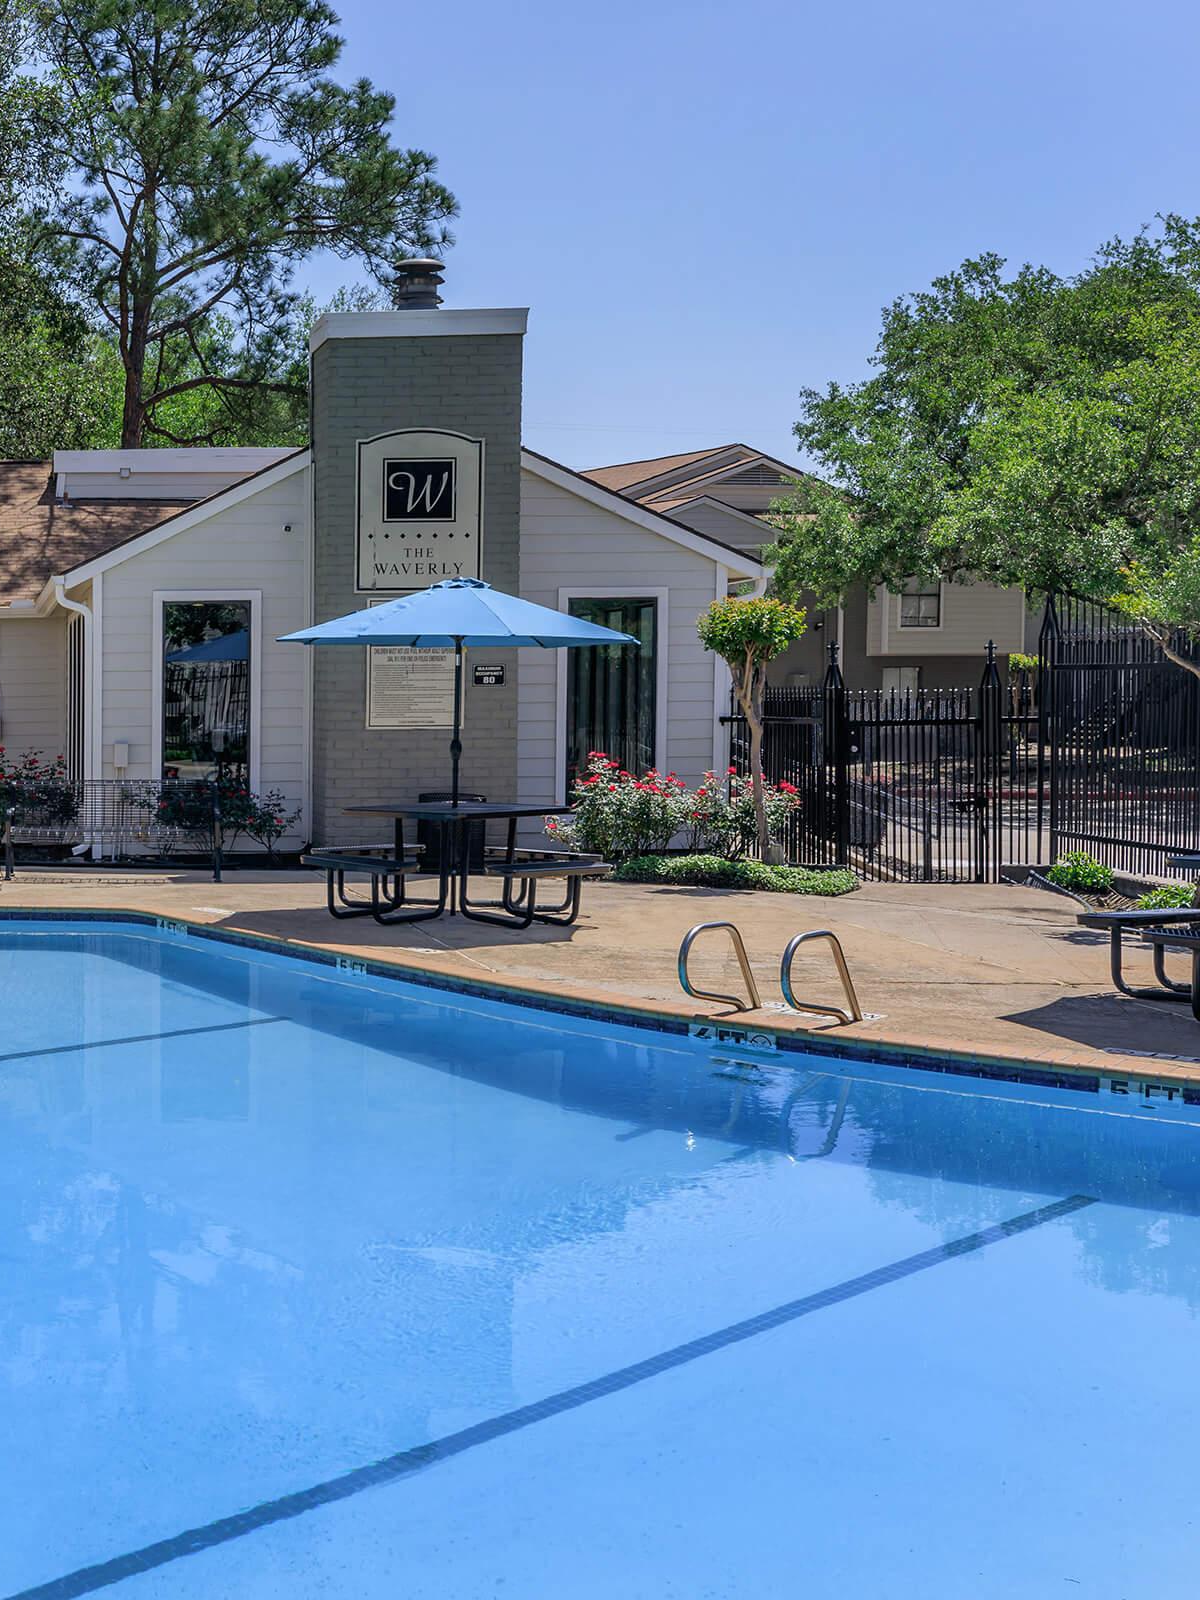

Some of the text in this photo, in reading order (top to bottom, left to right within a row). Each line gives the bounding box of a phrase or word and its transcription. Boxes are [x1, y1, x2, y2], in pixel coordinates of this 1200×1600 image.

[388, 471, 448, 512] W
[403, 547, 434, 558] THE
[374, 562, 464, 575] WAVERLY
[483, 676, 495, 684] 80
[718, 1029, 745, 1044] FT
[1111, 1080, 1180, 1101] 5 FT
